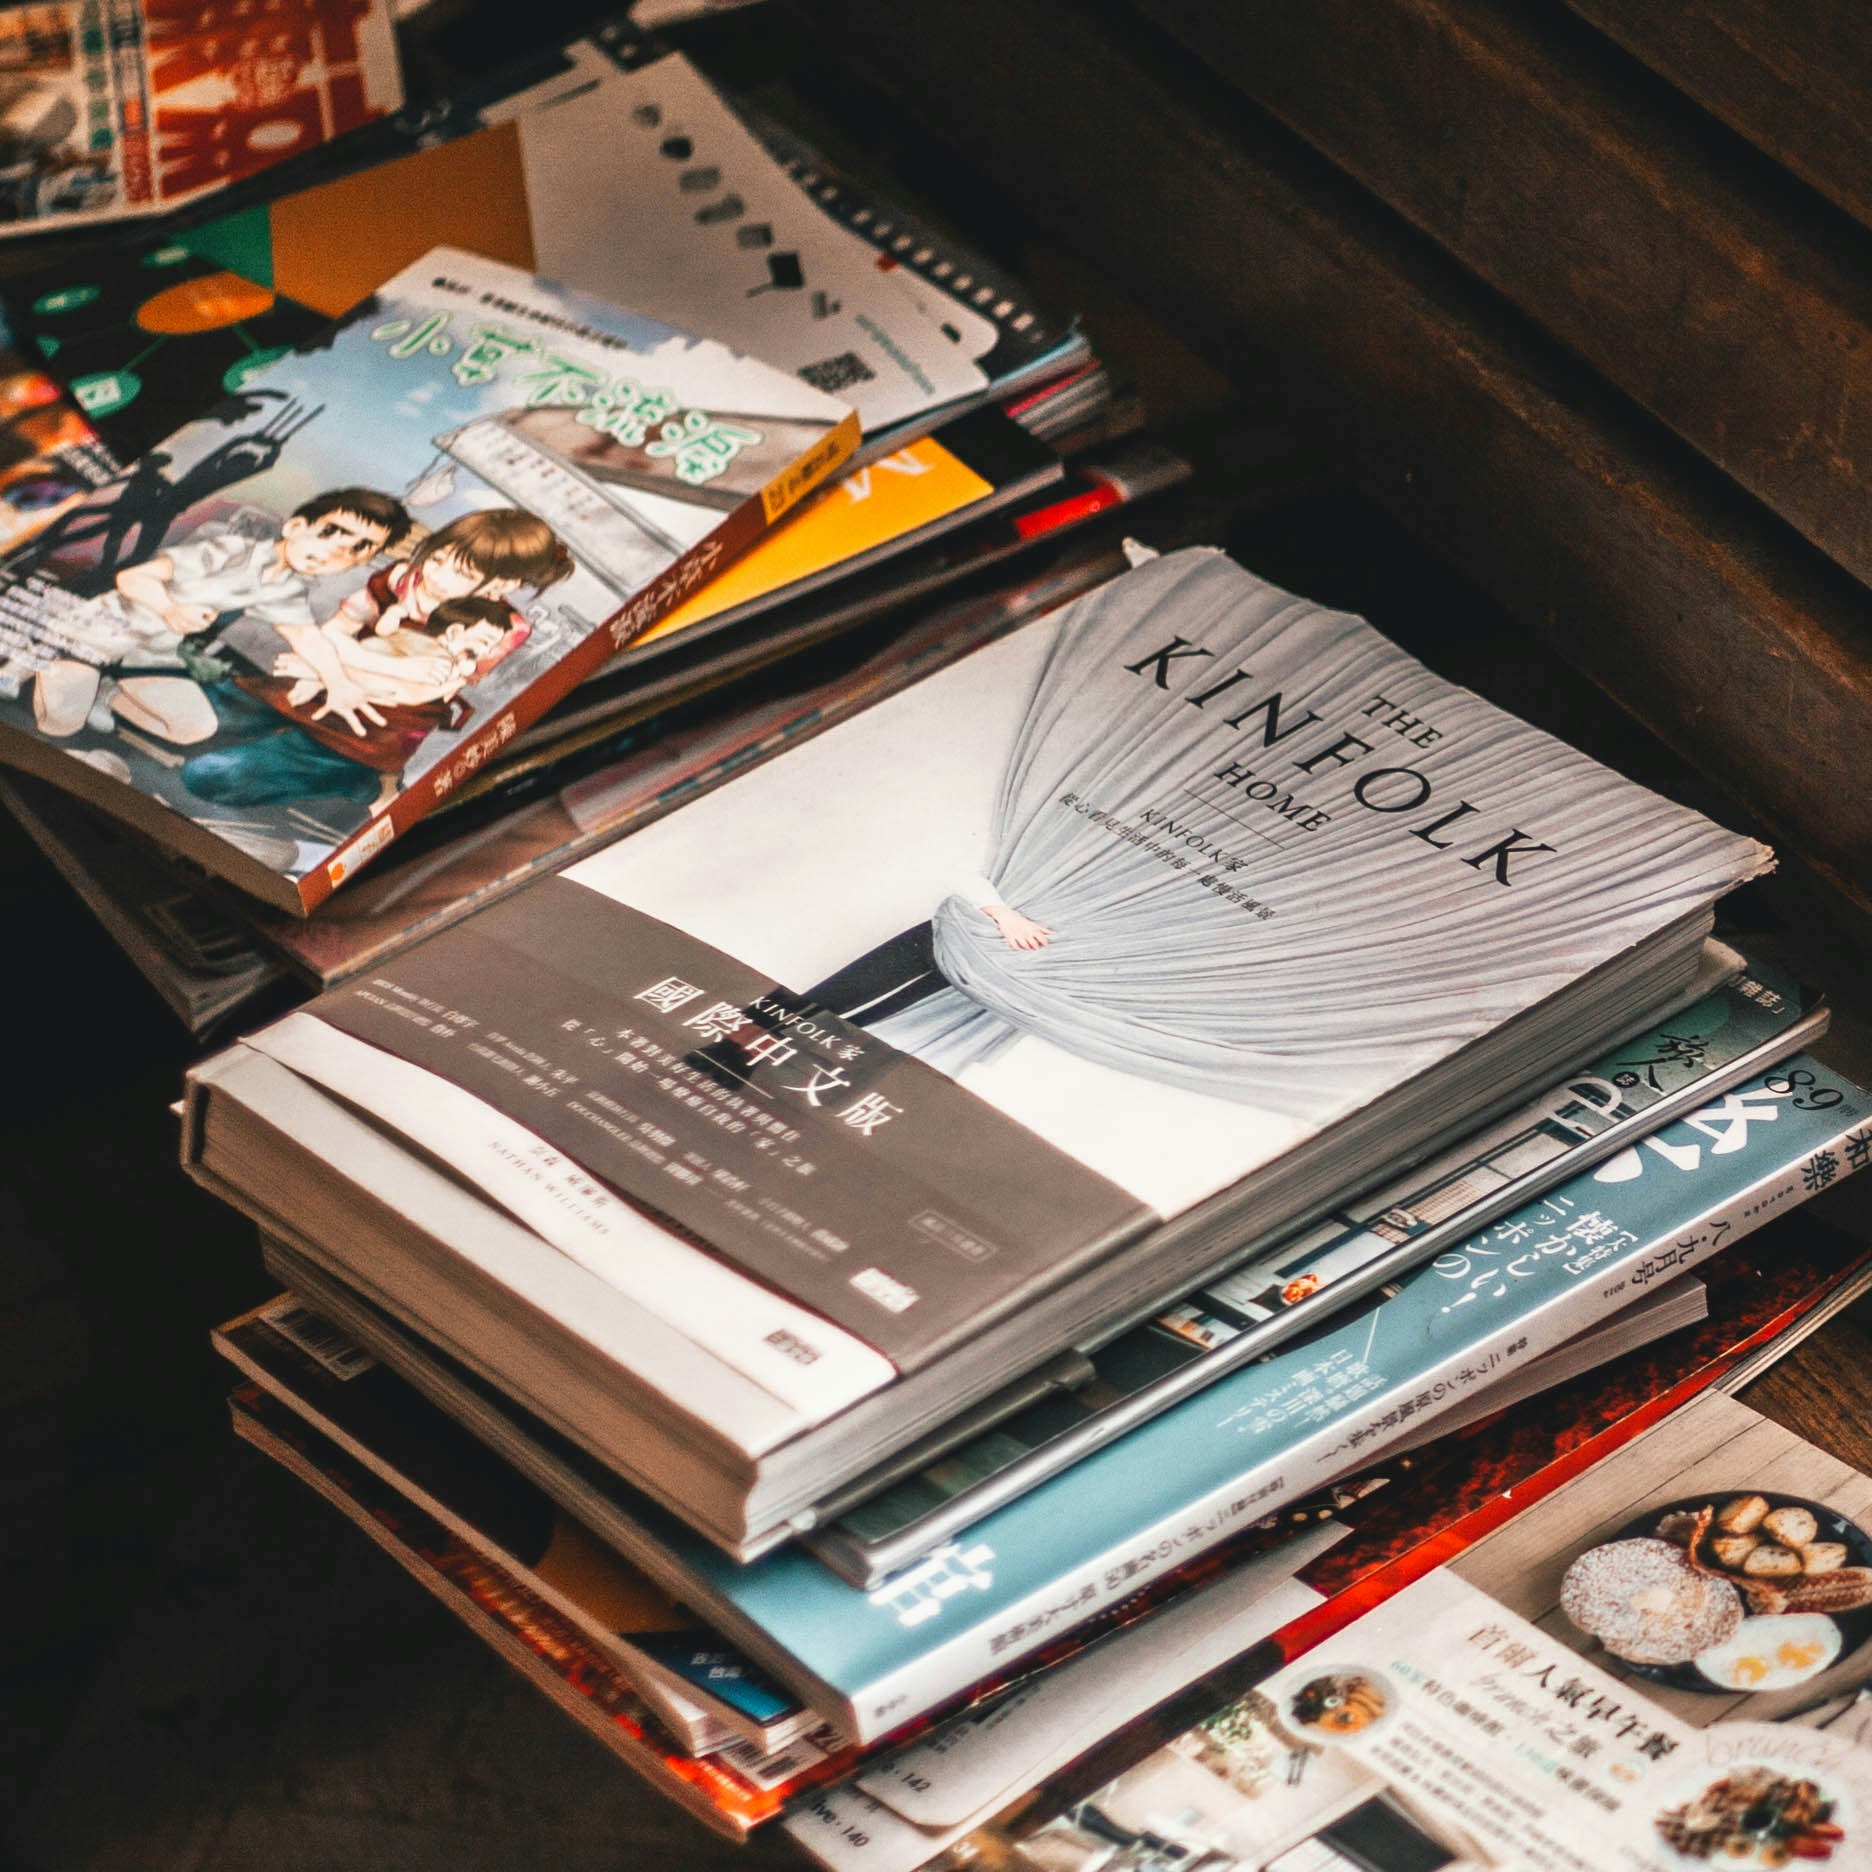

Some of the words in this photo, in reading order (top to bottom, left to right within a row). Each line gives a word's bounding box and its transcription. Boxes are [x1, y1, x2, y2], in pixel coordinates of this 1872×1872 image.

[1118, 634, 1567, 888] KINFOLK
[1352, 694, 1451, 750] THE
[1211, 762, 1334, 833] HOME
[631, 973, 909, 1138] 國際中文版
[748, 993, 843, 1049] KINFOLK
[486, 1140, 546, 1183] NATHAN
[541, 1181, 613, 1236] WILLIAMS
[1433, 1195, 1576, 1281] ニッポンの
[1467, 1623, 1681, 1761] 首爾人氣早午餐
[901, 1772, 932, 1793] 142
[841, 1826, 870, 1848] 140
